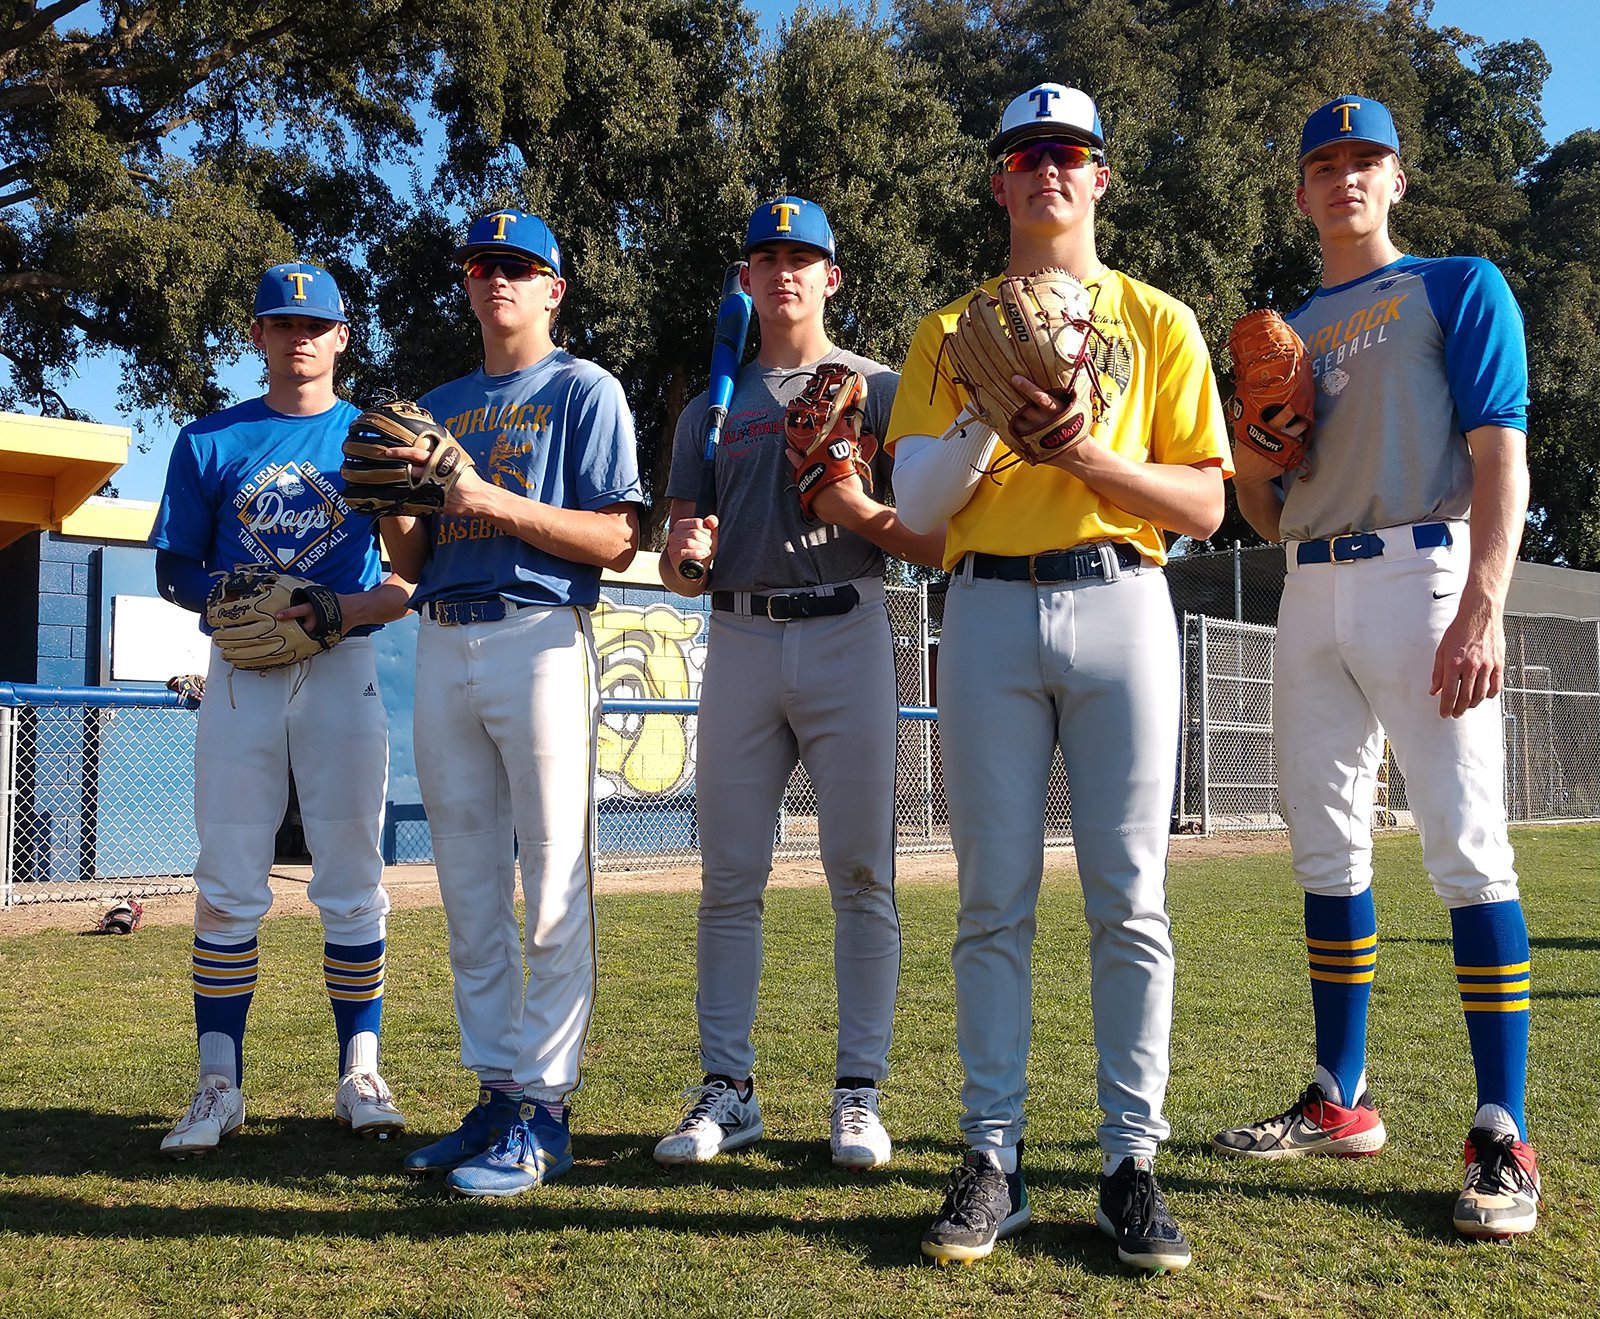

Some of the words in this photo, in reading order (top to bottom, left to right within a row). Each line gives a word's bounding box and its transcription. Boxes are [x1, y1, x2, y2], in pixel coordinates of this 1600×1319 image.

[1029, 87, 1060, 117] T
[1332, 103, 1360, 132] T
[490, 213, 517, 241] T
[771, 203, 800, 232] T
[287, 272, 313, 300] T
[1005, 302, 1030, 343] A2000
[1306, 293, 1409, 358] RLOCK
[1313, 325, 1388, 378] SEBALL
[444, 403, 553, 439] TURLOCK
[1044, 414, 1084, 447] Wilson
[828, 438, 850, 459] W
[1248, 425, 1283, 452] Wilson
[232, 483, 256, 509] 2019
[253, 462, 283, 485] CCAL
[798, 464, 824, 493] Wilson
[249, 491, 330, 539] Dogs
[436, 517, 511, 546] BASEBA
[237, 528, 274, 570] TURLOCK
